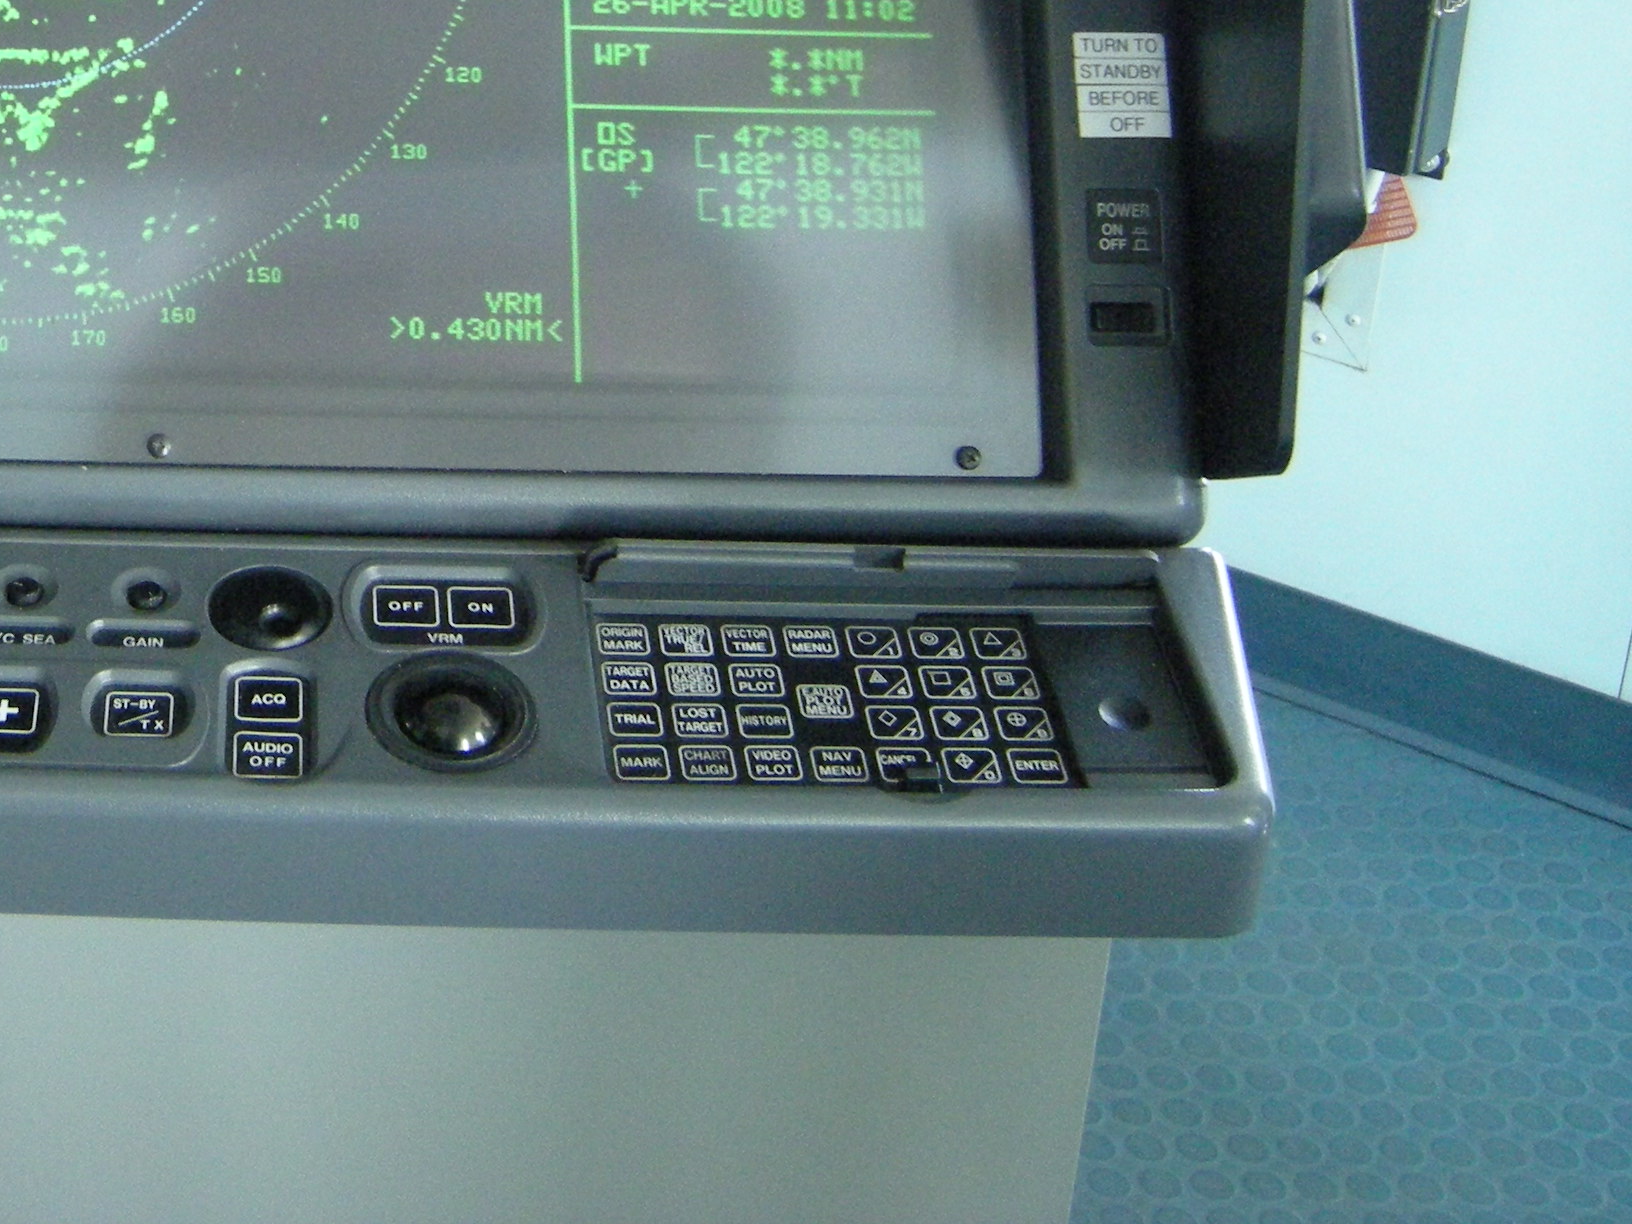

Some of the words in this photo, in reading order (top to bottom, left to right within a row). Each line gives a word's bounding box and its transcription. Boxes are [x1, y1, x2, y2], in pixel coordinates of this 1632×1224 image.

[1080, 37, 1128, 53] TURN
[1134, 37, 1158, 53] TO
[594, 42, 652, 67] WPT
[444, 66, 483, 83] 120
[1079, 63, 1161, 79] STANDBY
[1088, 90, 1160, 106] BEFORE
[1110, 116, 1145, 132] OFF
[596, 122, 636, 146] OS
[390, 144, 428, 160] 130
[1096, 202, 1151, 218] POWER
[323, 213, 360, 230] 140
[1101, 223, 1123, 236] ON
[1099, 237, 1127, 251] OFF
[246, 267, 283, 284] 150
[484, 291, 543, 315] VRM
[160, 307, 196, 324] 160
[71, 330, 106, 347] 170
[387, 599, 425, 613] OFF
[467, 601, 495, 614] ON
[426, 631, 465, 645] VRM
[601, 626, 644, 638] ORIGIN
[726, 629, 768, 639] VECTOR
[788, 629, 831, 639] RADAR
[21, 632, 57, 646] SEA
[122, 634, 165, 649] GAIN
[603, 640, 644, 651] MARK
[732, 641, 766, 652] TIME
[791, 642, 833, 653] MENU
[606, 665, 649, 677] TARGET
[735, 667, 775, 679] AUTO
[609, 679, 650, 691] DATA
[738, 681, 776, 693] PLOT
[112, 698, 156, 711] ST-BY
[250, 691, 287, 706] ACQ
[678, 707, 717, 719] LOST
[805, 705, 848, 715] MENU
[614, 713, 656, 725] TRIAL
[741, 715, 787, 726] HISTORY
[678, 721, 723, 733] TARGET
[242, 740, 294, 755] AUDIO
[248, 755, 287, 769] OFF
[620, 756, 663, 768] MARK
[684, 750, 728, 761] CHART
[752, 750, 791, 762] VIDEO
[821, 751, 852, 762] NAV
[689, 764, 730, 776] ALIGN
[755, 765, 794, 776] PLOT
[818, 764, 862, 777] MENU
[1015, 759, 1059, 772] ENTER
